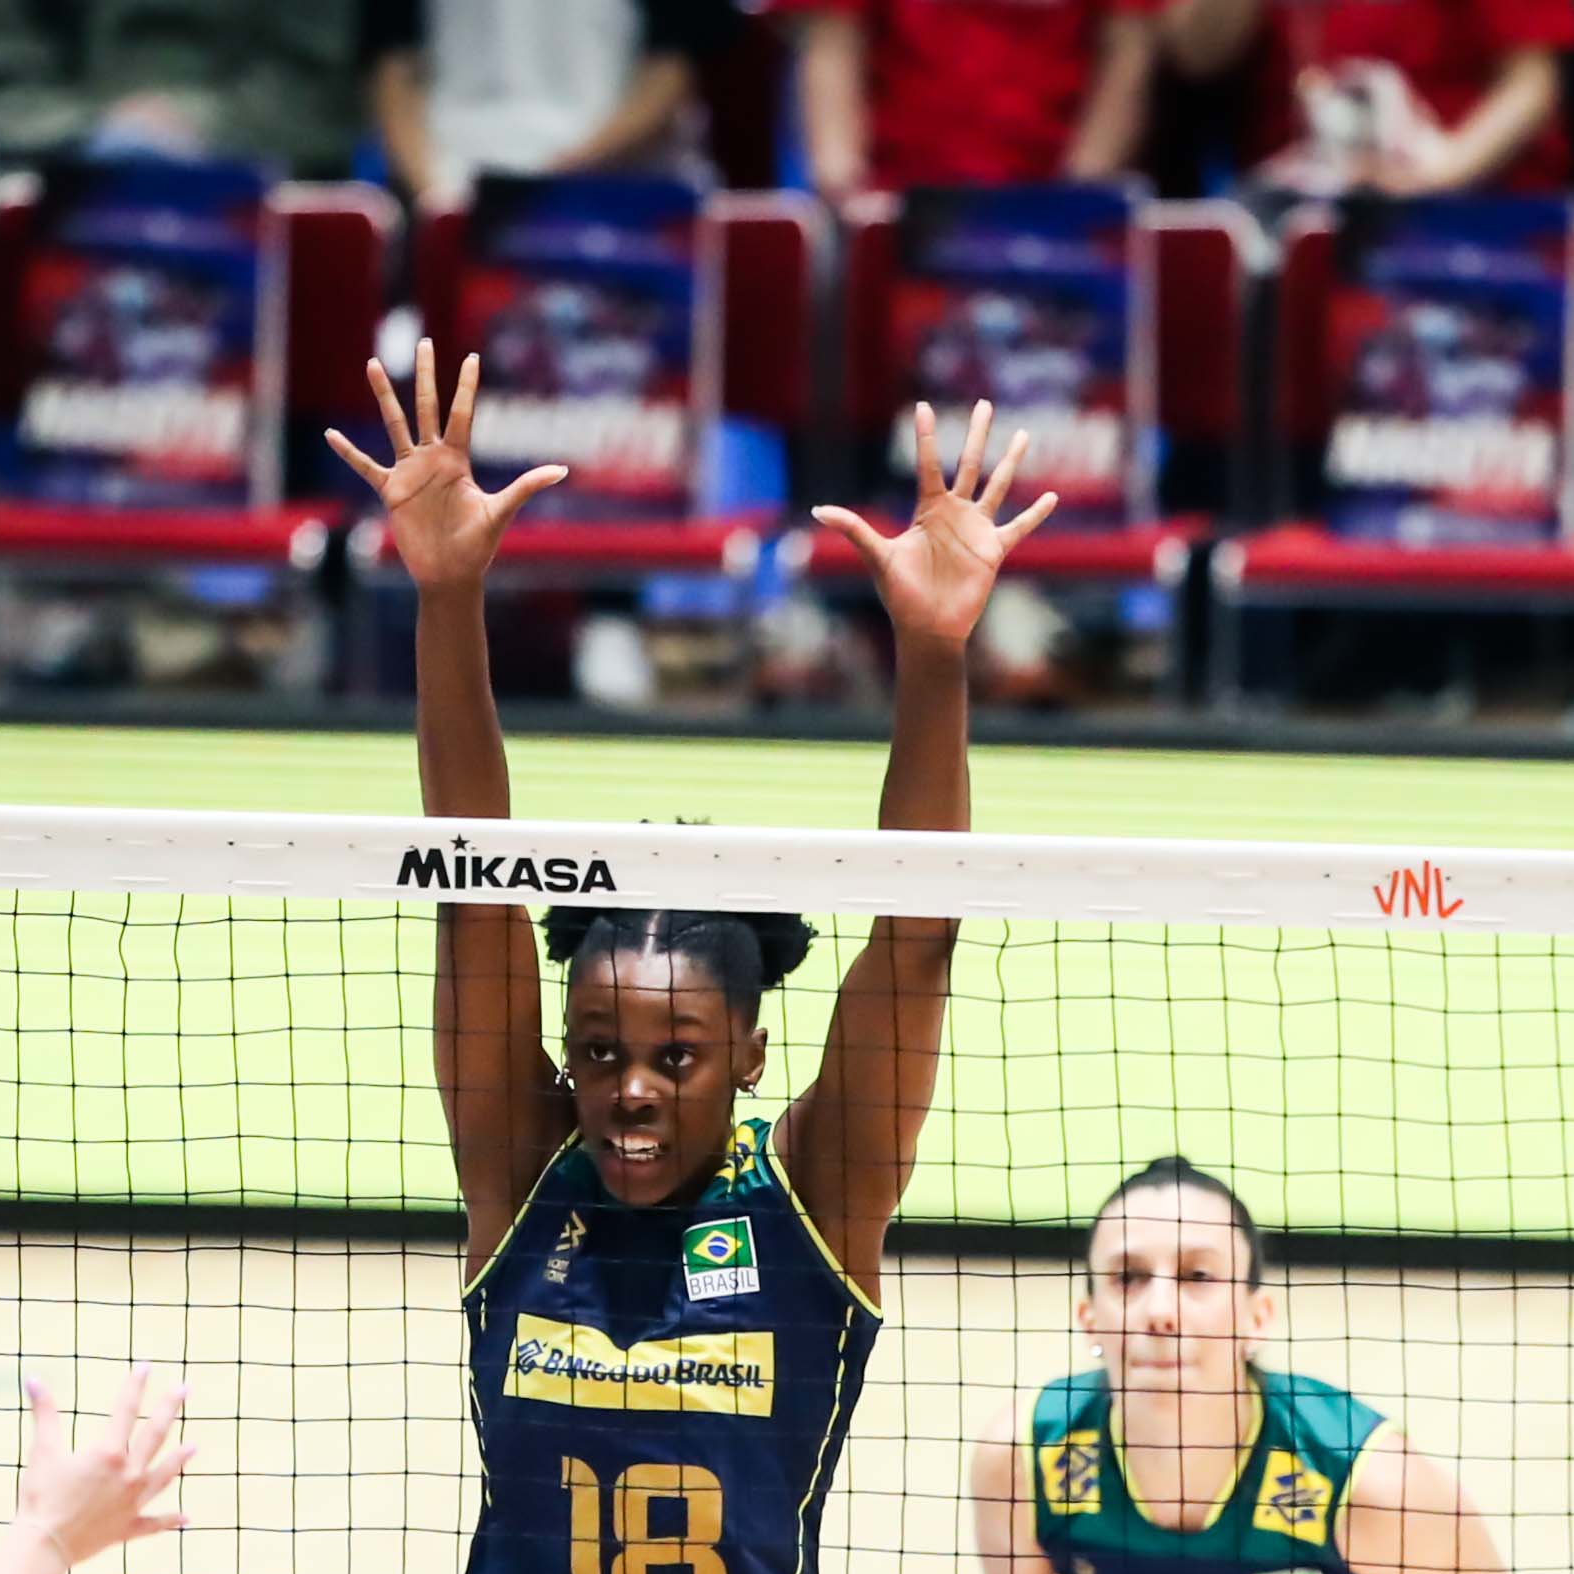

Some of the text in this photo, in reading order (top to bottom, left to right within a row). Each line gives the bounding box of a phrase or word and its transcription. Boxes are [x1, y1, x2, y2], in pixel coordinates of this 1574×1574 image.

[397, 834, 617, 894] MIKASA
[1374, 860, 1464, 919] VNL
[690, 1268, 757, 1297] BRASIL
[675, 1358, 766, 1389] BRASIL
